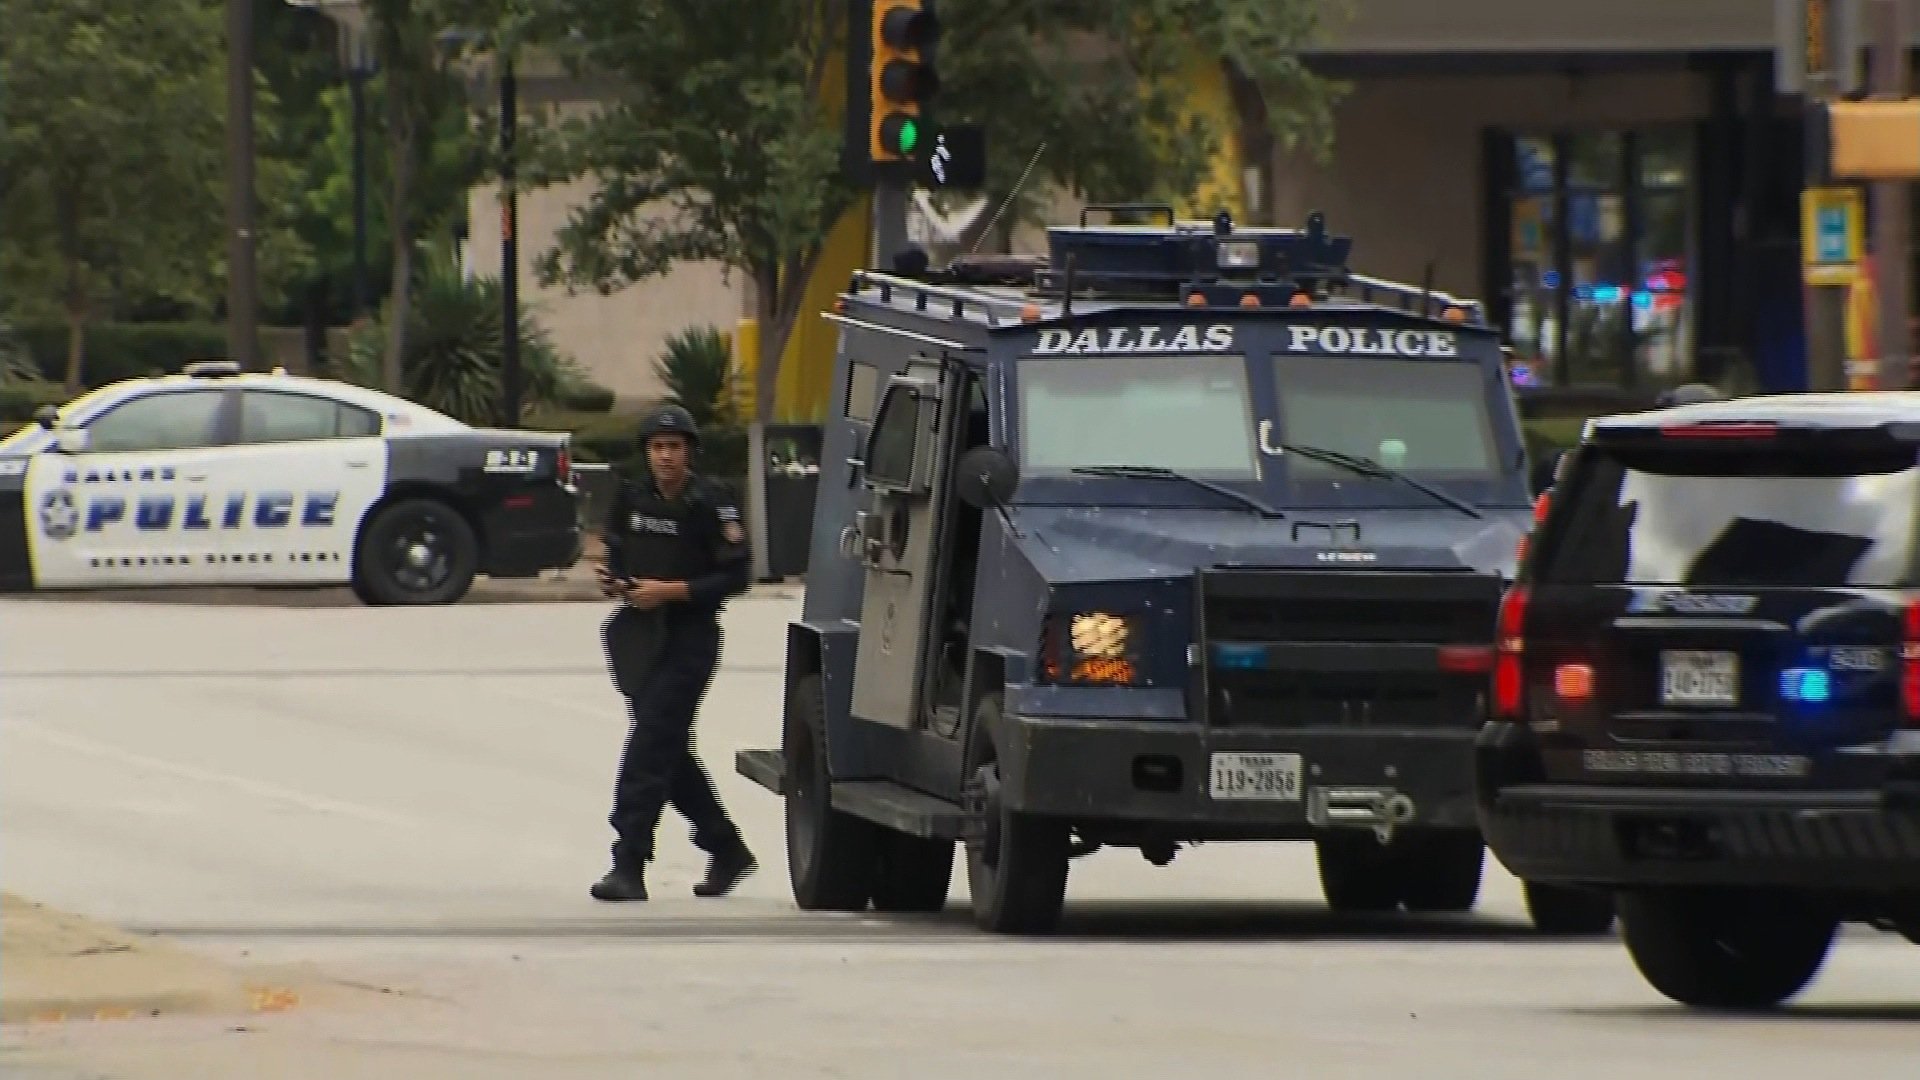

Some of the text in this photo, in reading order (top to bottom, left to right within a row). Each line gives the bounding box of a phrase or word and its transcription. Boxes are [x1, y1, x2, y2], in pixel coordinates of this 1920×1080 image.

[1032, 324, 1456, 356] DALLAS POLICE
[64, 468, 175, 484] DALLAS
[85, 492, 340, 531] POLICE
[641, 516, 680, 536] POLICE
